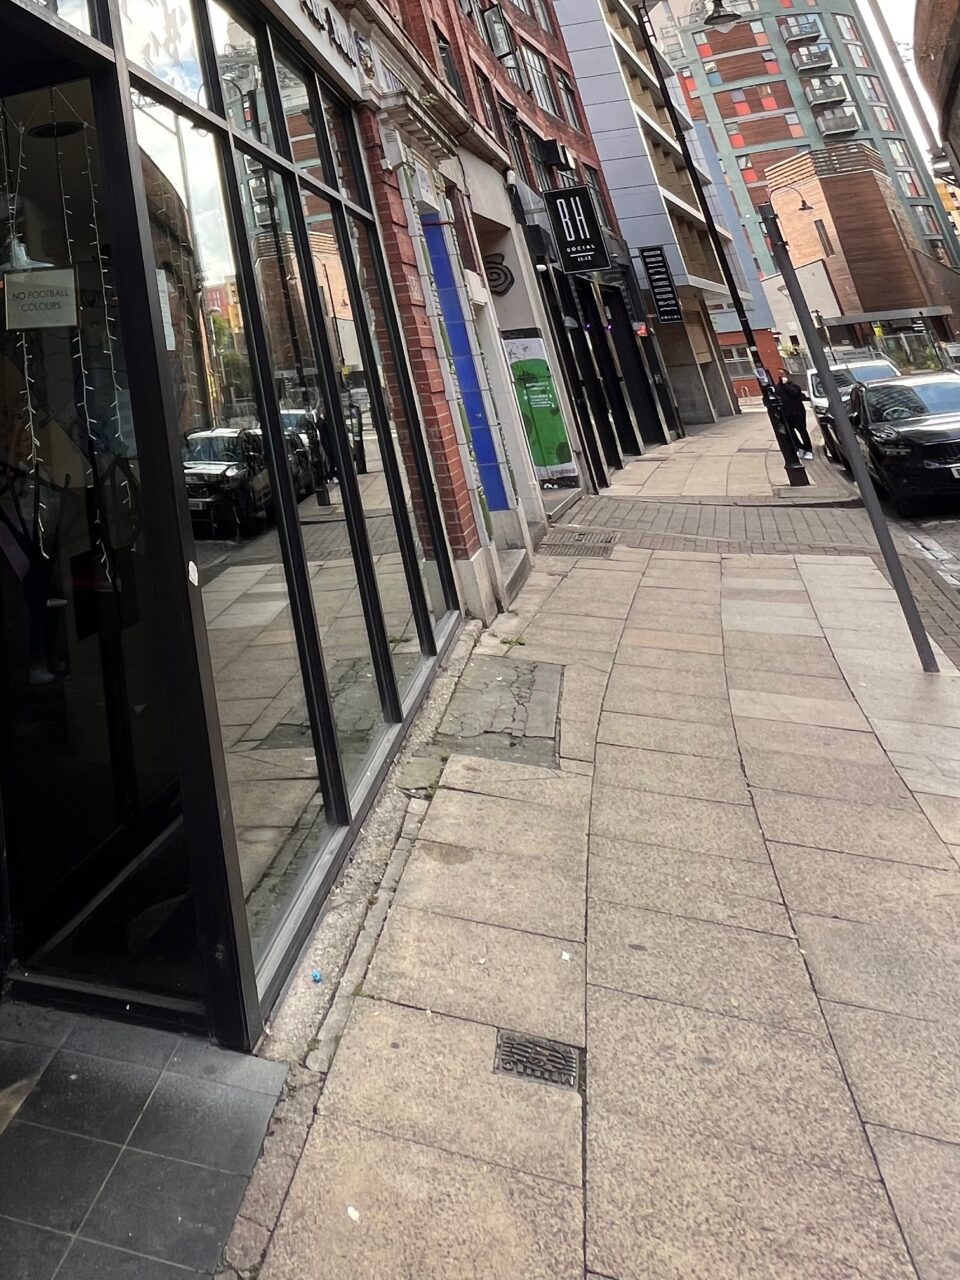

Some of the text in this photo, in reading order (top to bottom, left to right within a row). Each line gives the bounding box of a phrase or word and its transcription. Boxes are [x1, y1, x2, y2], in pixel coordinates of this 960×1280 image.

[556, 196, 590, 241] BH
[566, 244, 595, 252] SOCIAL
[12, 287, 69, 301] NO FOOTBALL
[21, 301, 62, 312] COLOURS
